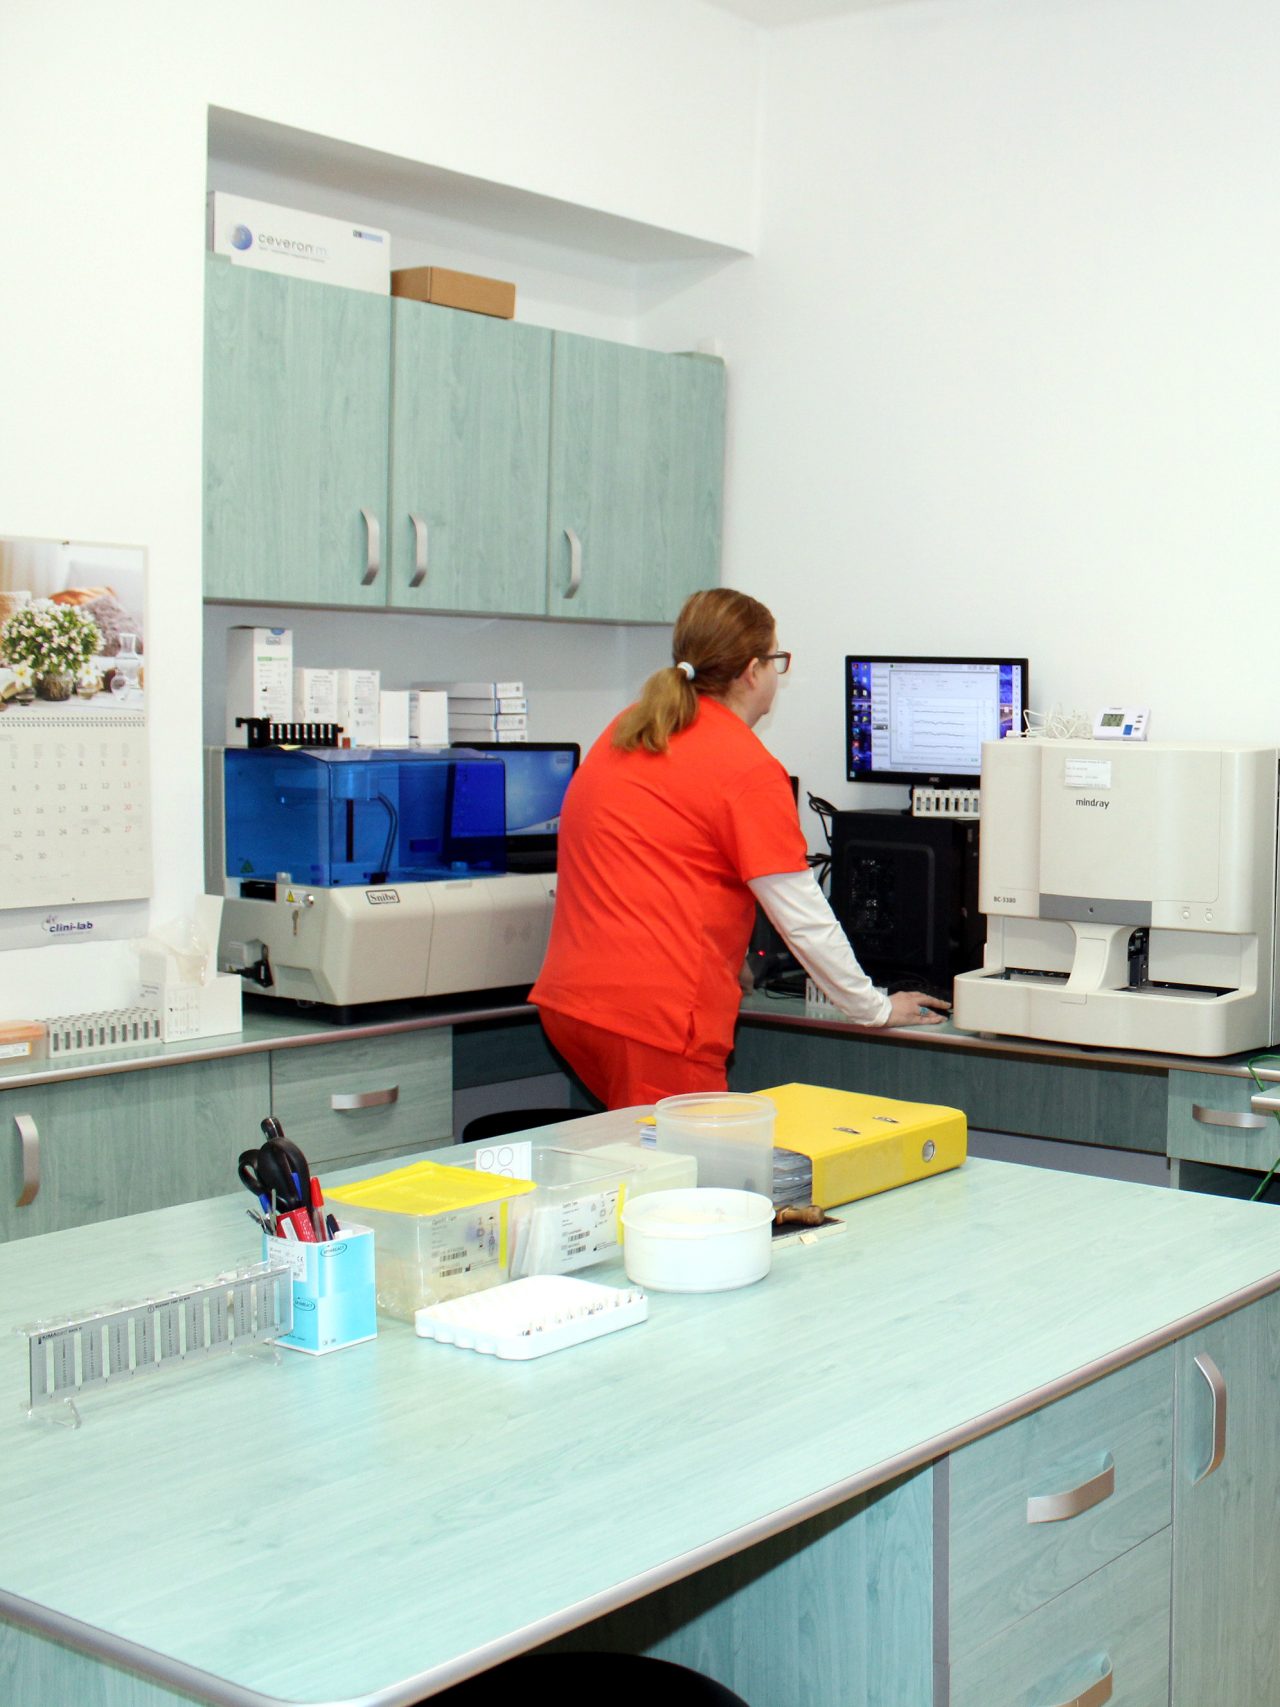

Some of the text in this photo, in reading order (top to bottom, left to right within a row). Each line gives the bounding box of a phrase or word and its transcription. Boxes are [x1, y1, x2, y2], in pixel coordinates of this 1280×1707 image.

[258, 231, 313, 254] ceveron
[1075, 797, 1110, 810] mindray
[370, 893, 397, 902] Snibe
[49, 920, 93, 933] clini-lab
